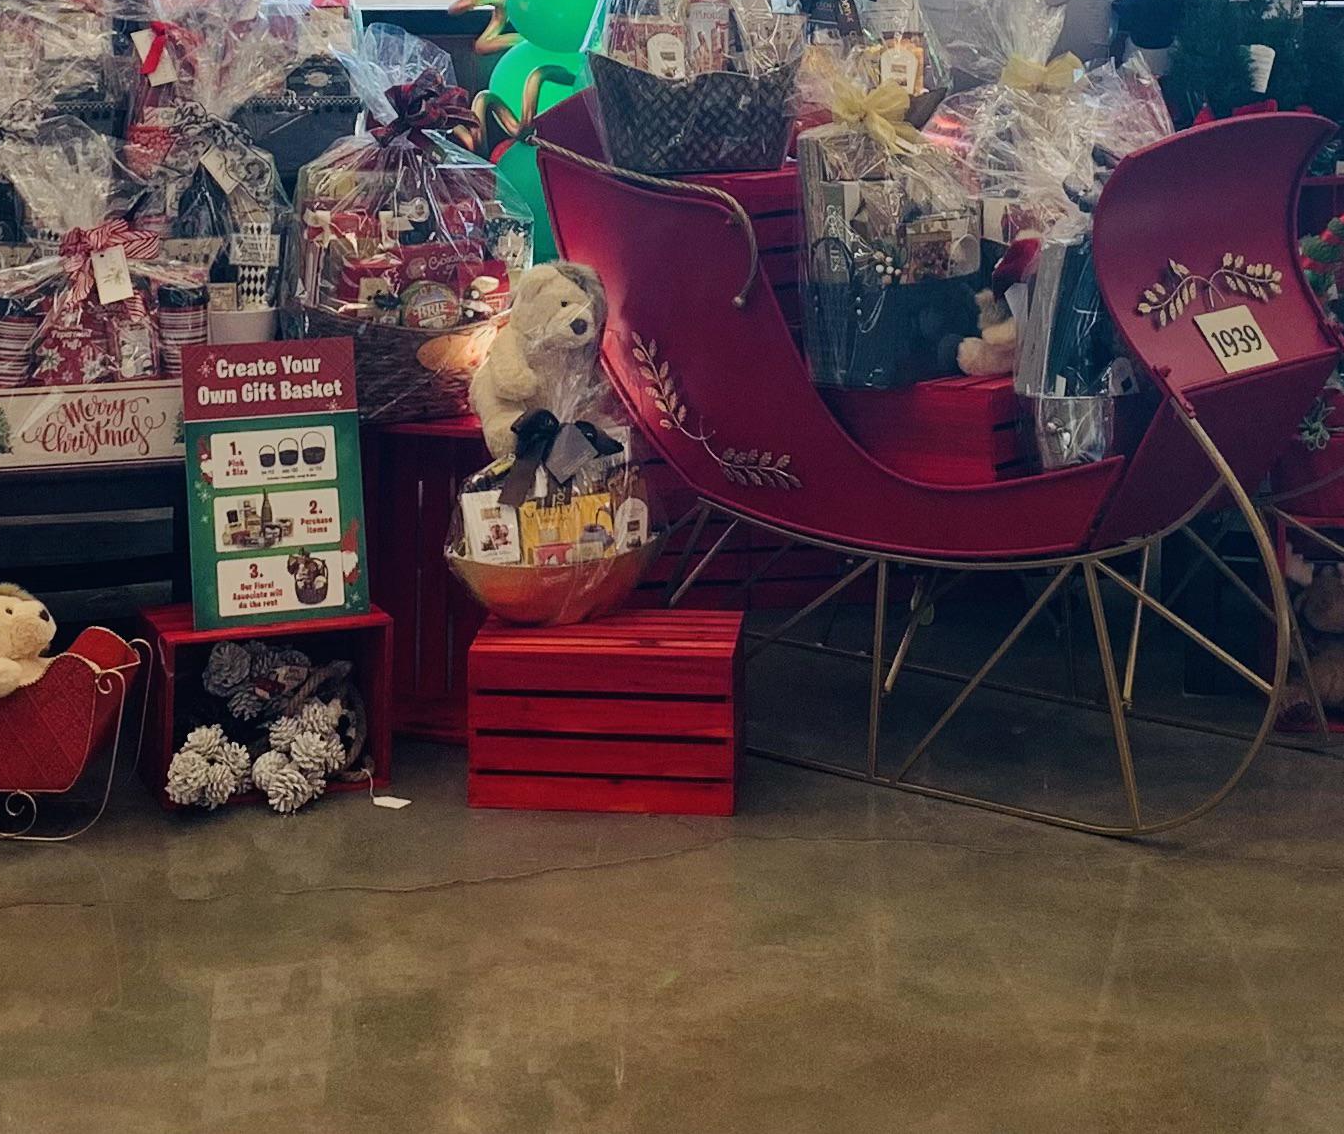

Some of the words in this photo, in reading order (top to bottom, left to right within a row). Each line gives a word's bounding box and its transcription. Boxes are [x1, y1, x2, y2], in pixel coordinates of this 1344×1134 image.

[418, 301, 448, 318] BRIE
[1211, 325, 1262, 357] 1939
[216, 359, 277, 379] Create
[281, 355, 321, 374] Your
[198, 386, 237, 405] Own
[241, 383, 277, 403] Gift
[280, 379, 342, 400] Basket
[47, 395, 150, 427] Merry
[21, 412, 166, 456] Christmas
[230, 441, 242, 456] 1.
[309, 500, 323, 514] 2.
[301, 517, 333, 526] Purchase
[249, 563, 264, 578] 3.
[263, 599, 278, 607] rest
